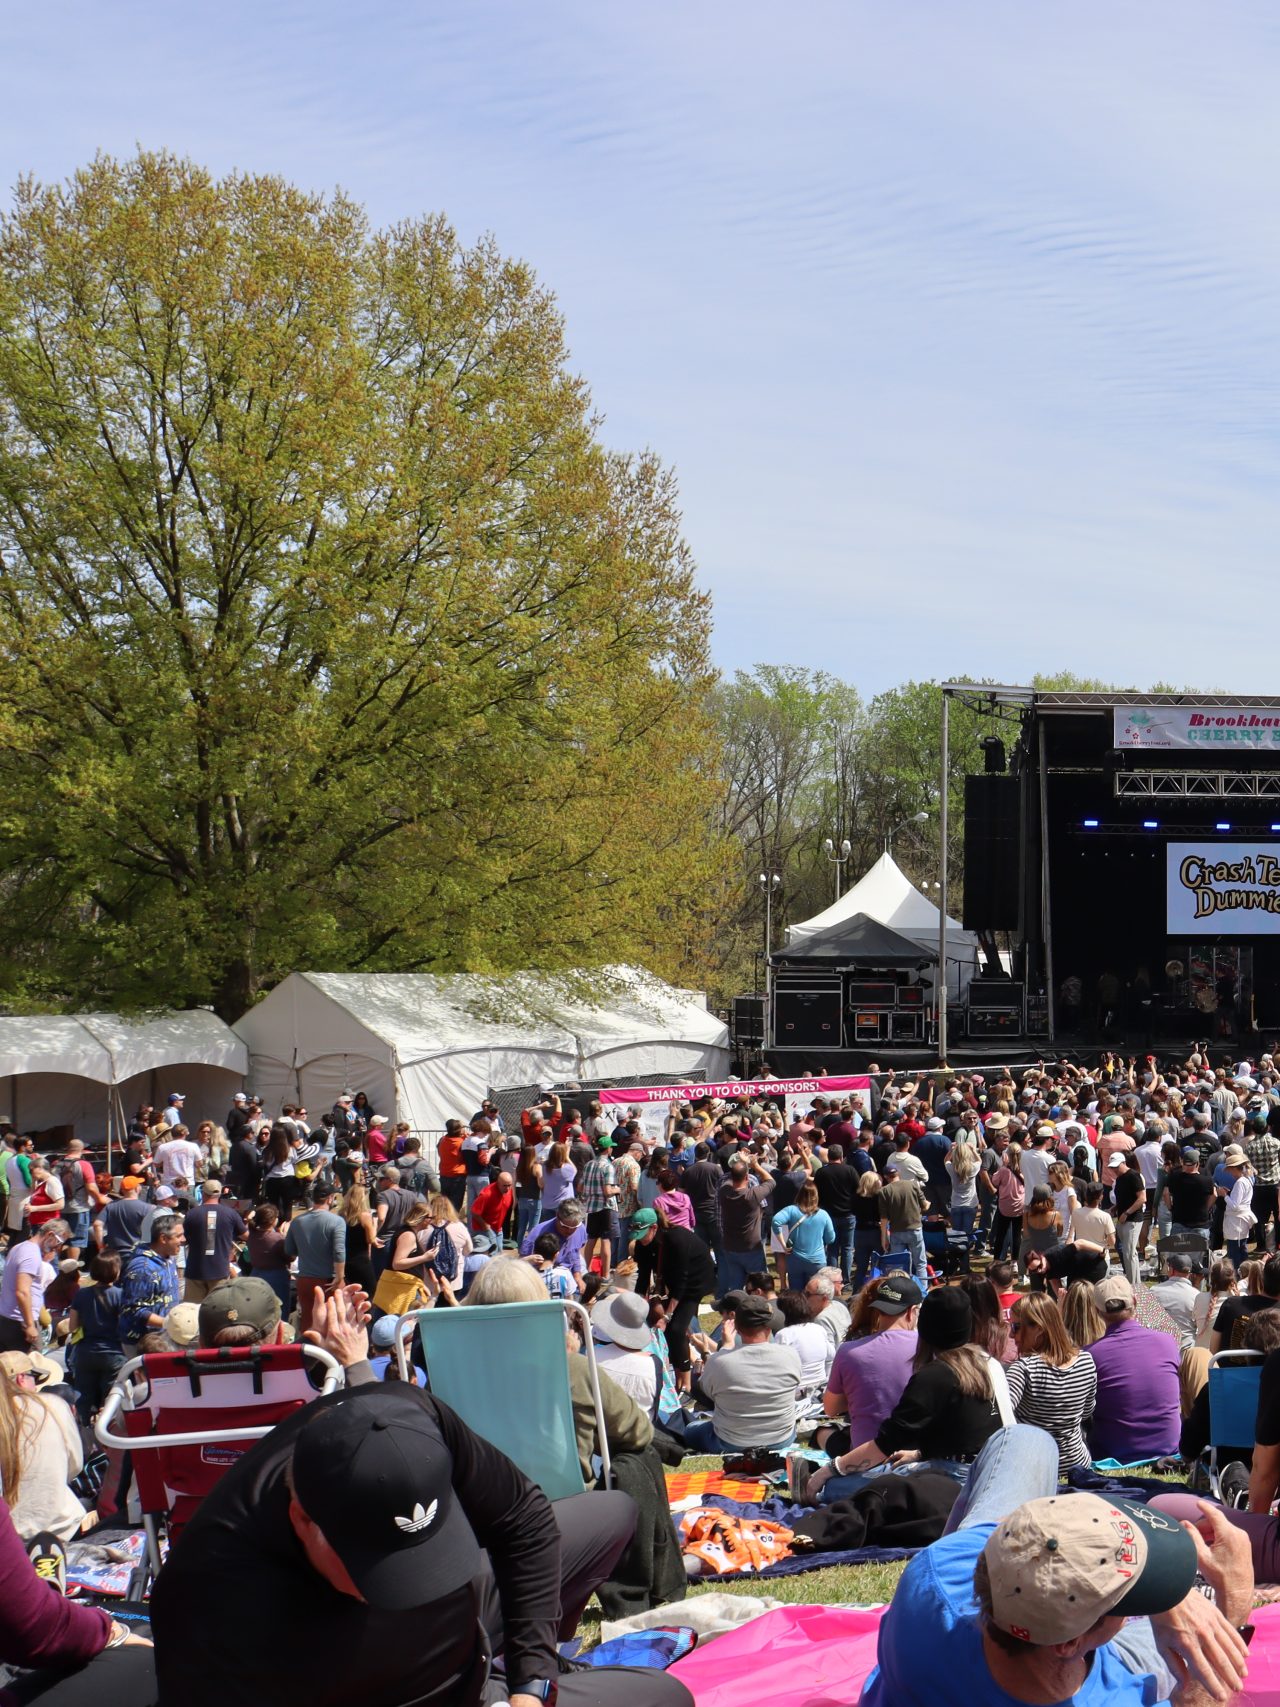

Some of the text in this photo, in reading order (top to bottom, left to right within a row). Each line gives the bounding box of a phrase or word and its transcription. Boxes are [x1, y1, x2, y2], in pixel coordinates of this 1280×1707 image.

[1187, 729, 1265, 742] CHERRY
[1180, 855, 1256, 889] Crash
[647, 1081, 820, 1100] THANK YOU TO OUR SPONSORS!
